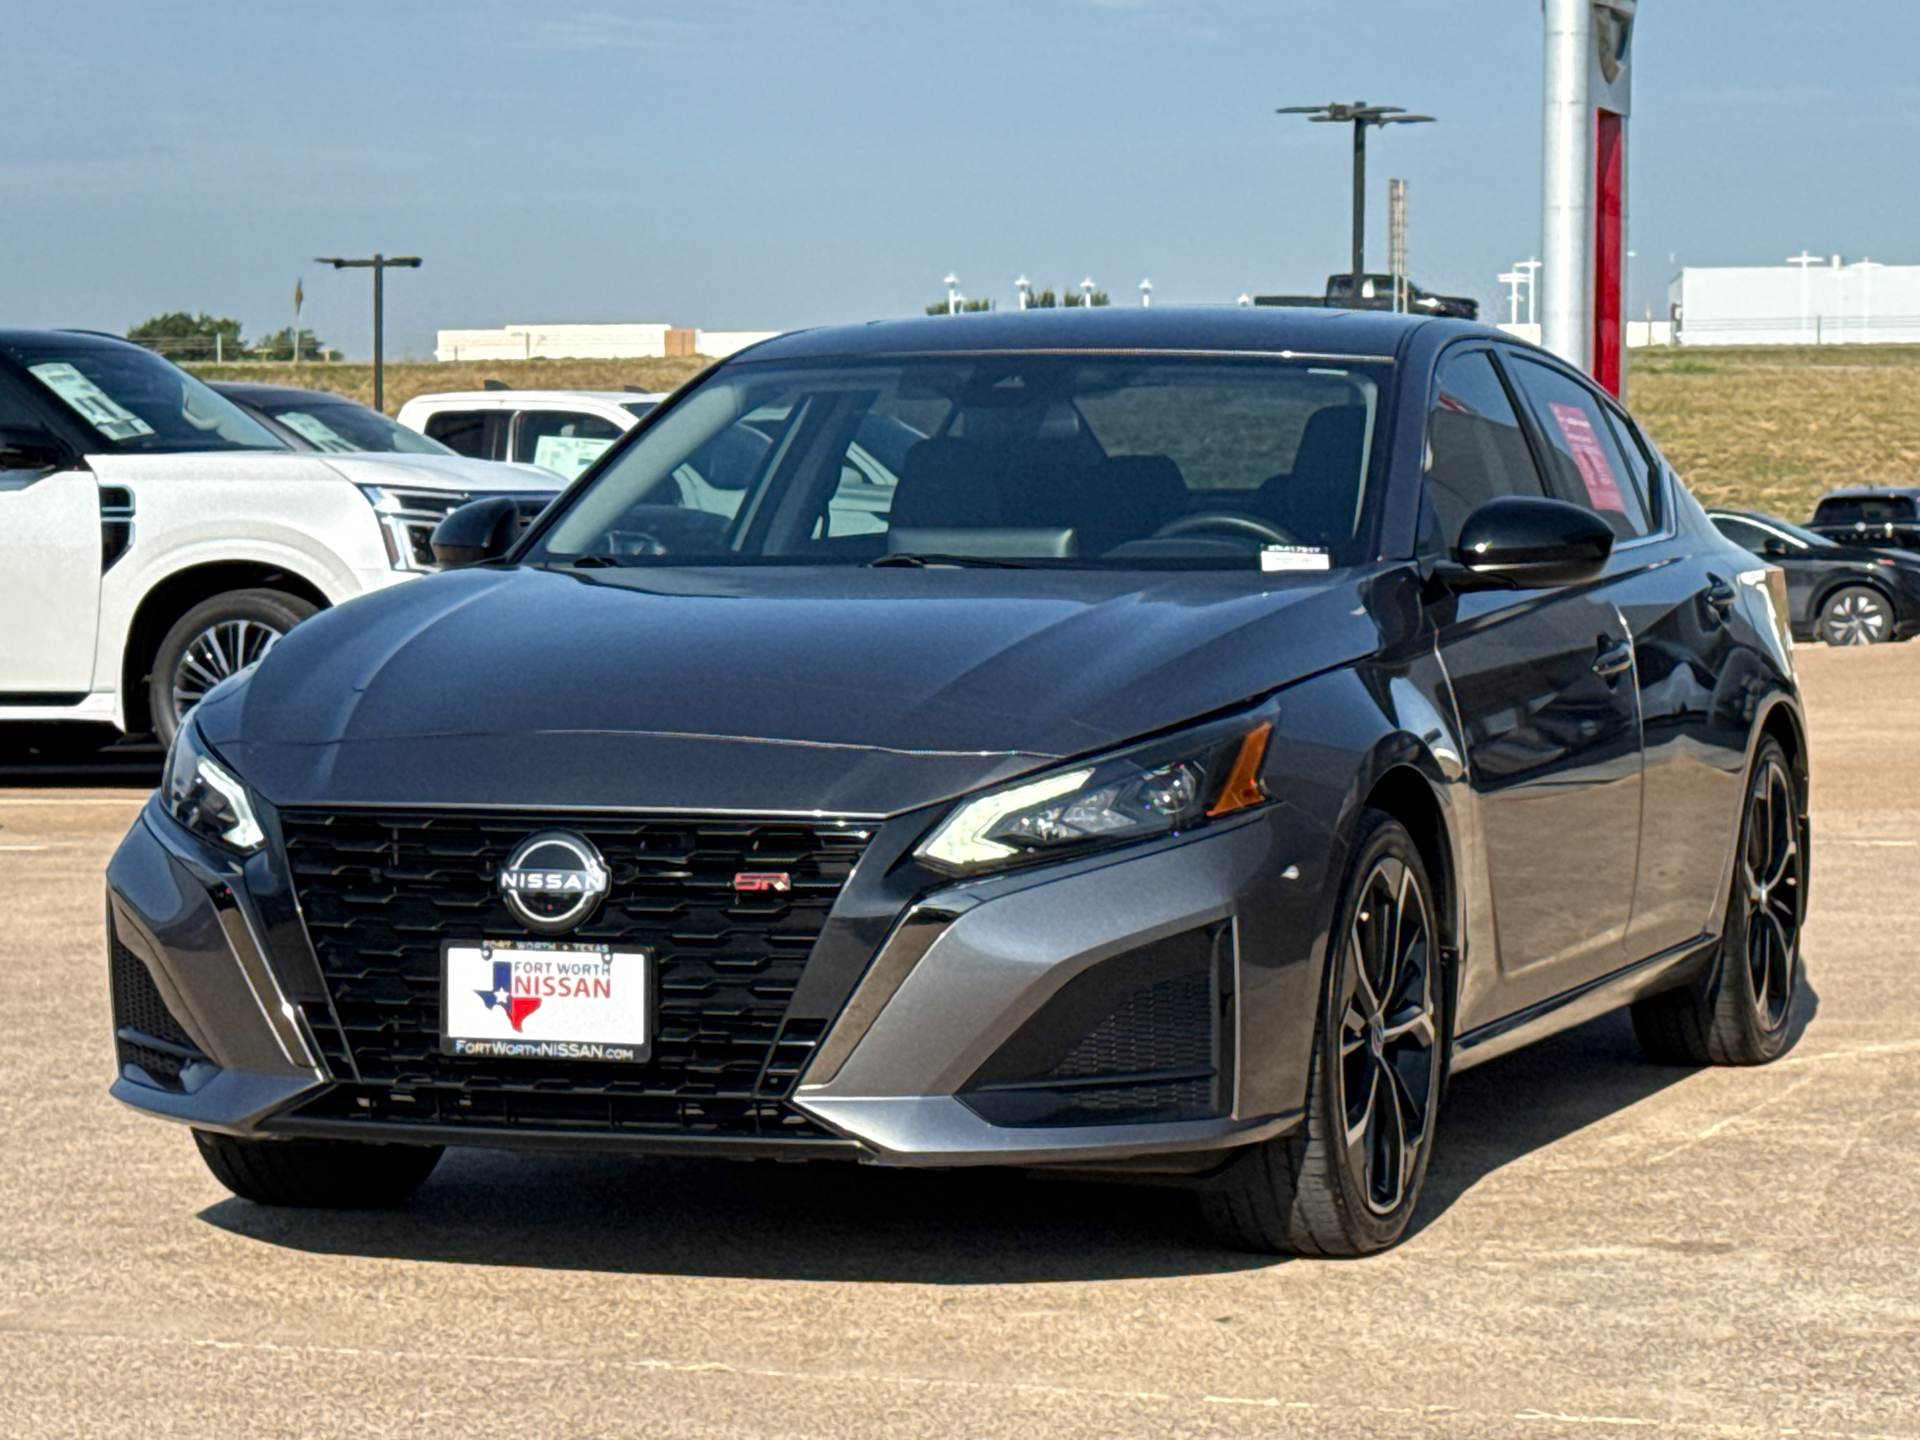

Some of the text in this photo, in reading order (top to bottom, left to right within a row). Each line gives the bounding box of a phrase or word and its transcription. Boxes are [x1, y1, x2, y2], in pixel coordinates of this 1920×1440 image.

[501, 872, 604, 890] NISSAN
[735, 872, 790, 891] SR
[482, 940, 610, 953] FORT WORTH TEXAS
[514, 961, 611, 977] FORT WORTH
[514, 976, 611, 999] NISSAN
